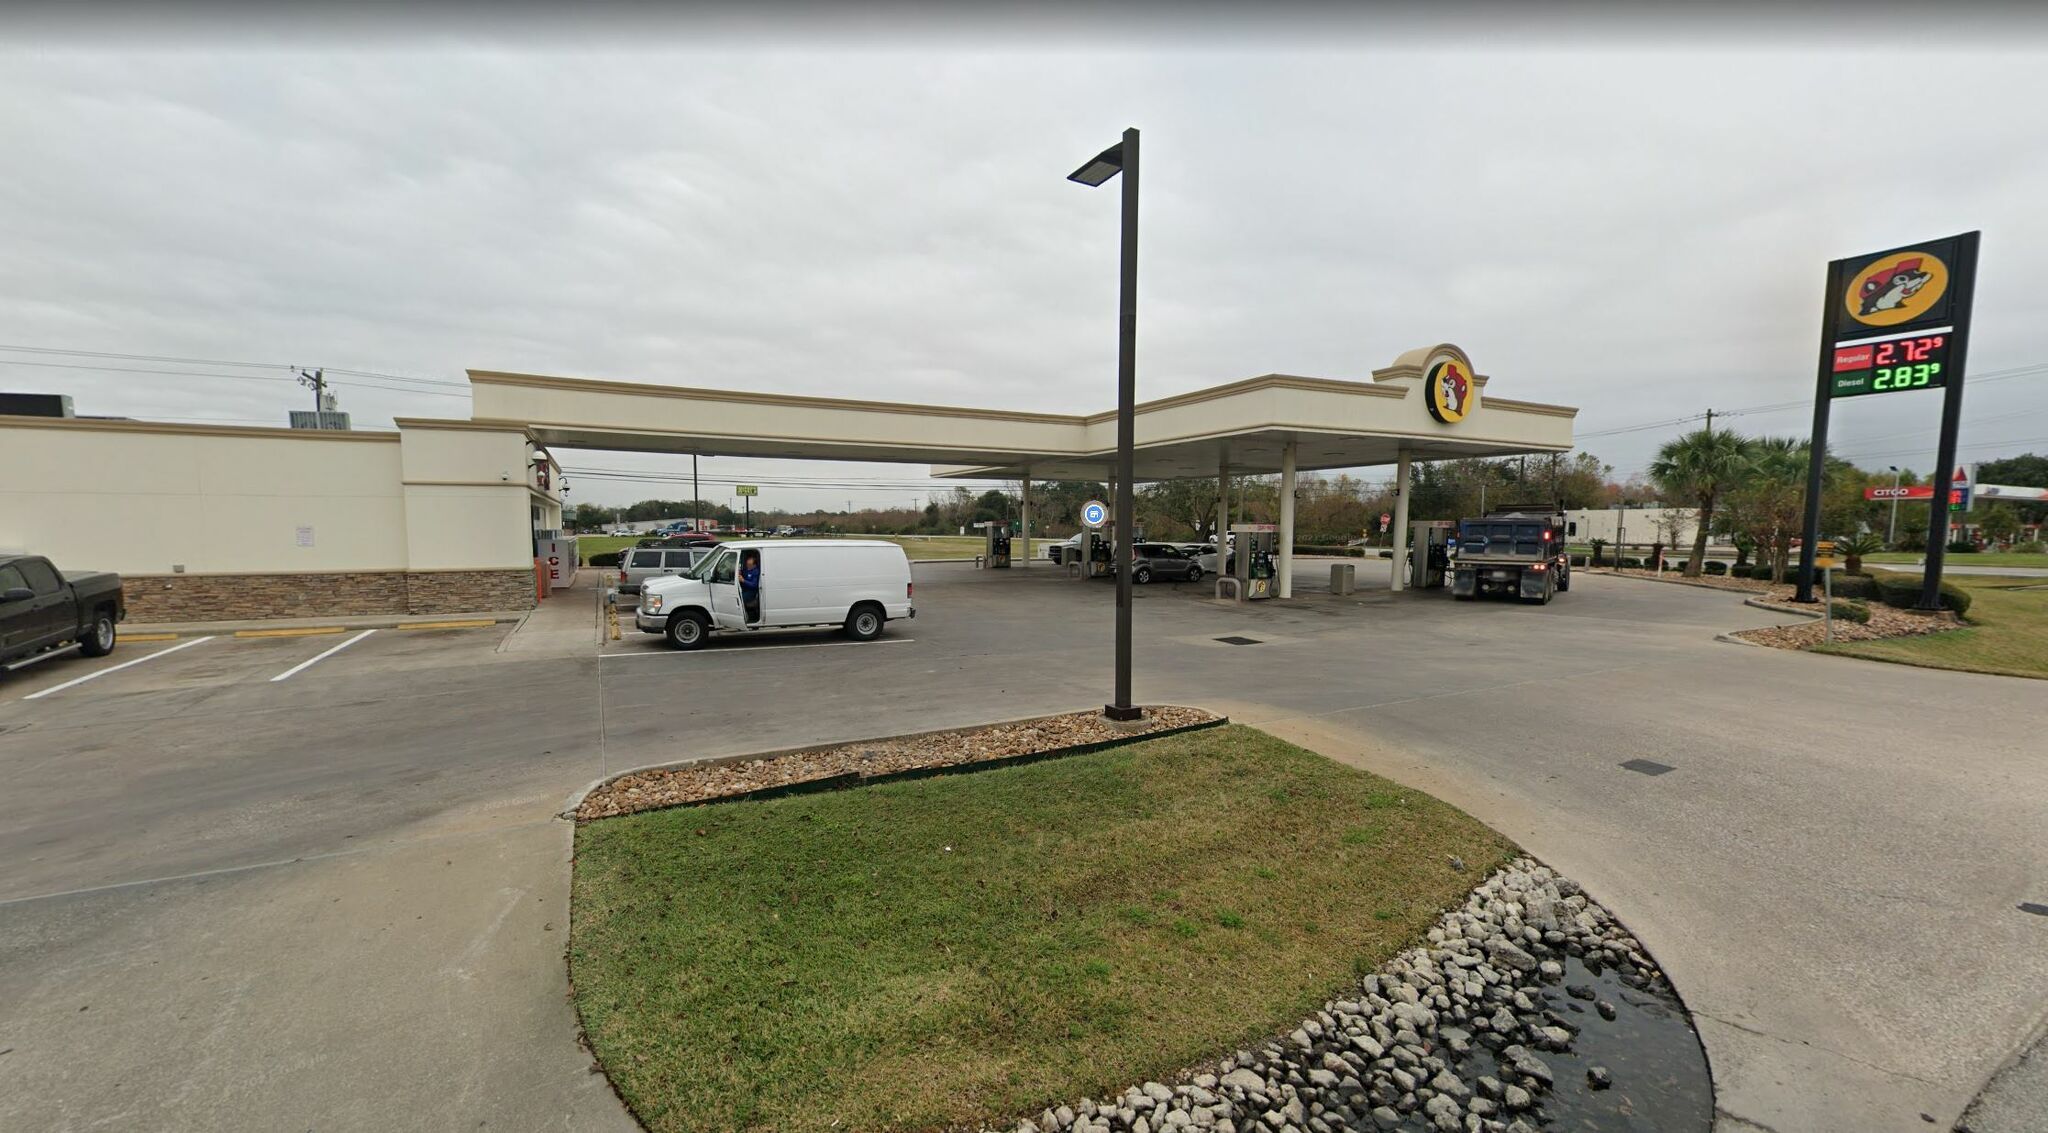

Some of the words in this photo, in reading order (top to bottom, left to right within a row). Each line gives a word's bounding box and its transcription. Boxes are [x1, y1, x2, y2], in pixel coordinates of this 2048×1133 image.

[1836, 353, 1871, 365] Regular
[1837, 378, 1864, 388] Diesel
[1874, 488, 1909, 496] CITGO
[548, 543, 560, 580] ICE
